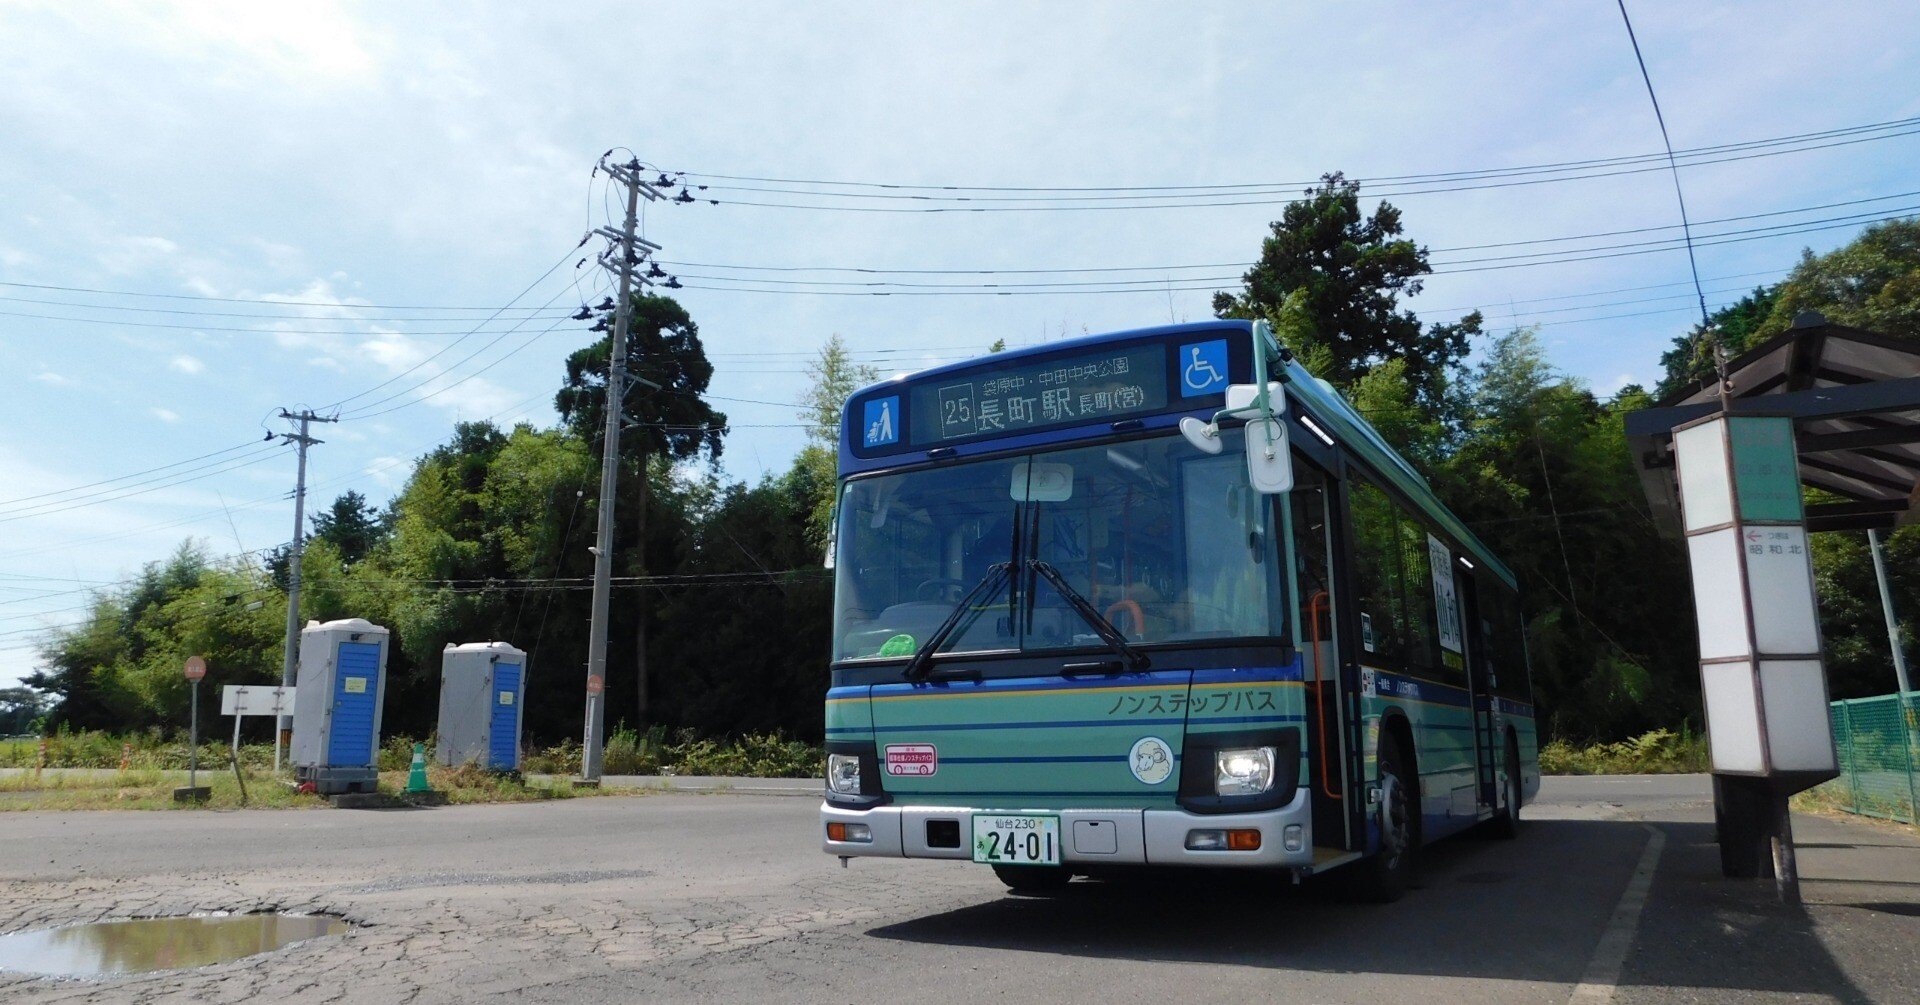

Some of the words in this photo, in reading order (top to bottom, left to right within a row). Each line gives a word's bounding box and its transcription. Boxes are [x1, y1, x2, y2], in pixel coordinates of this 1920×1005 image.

[945, 397, 971, 425] 25
[977, 387, 1075, 431] 長町駅
[1748, 544, 1802, 555] 昭和北
[1108, 691, 1276, 715] ノンステップバス
[889, 754, 933, 762] 仕ノンステップバス
[987, 830, 1052, 861] 24-01
